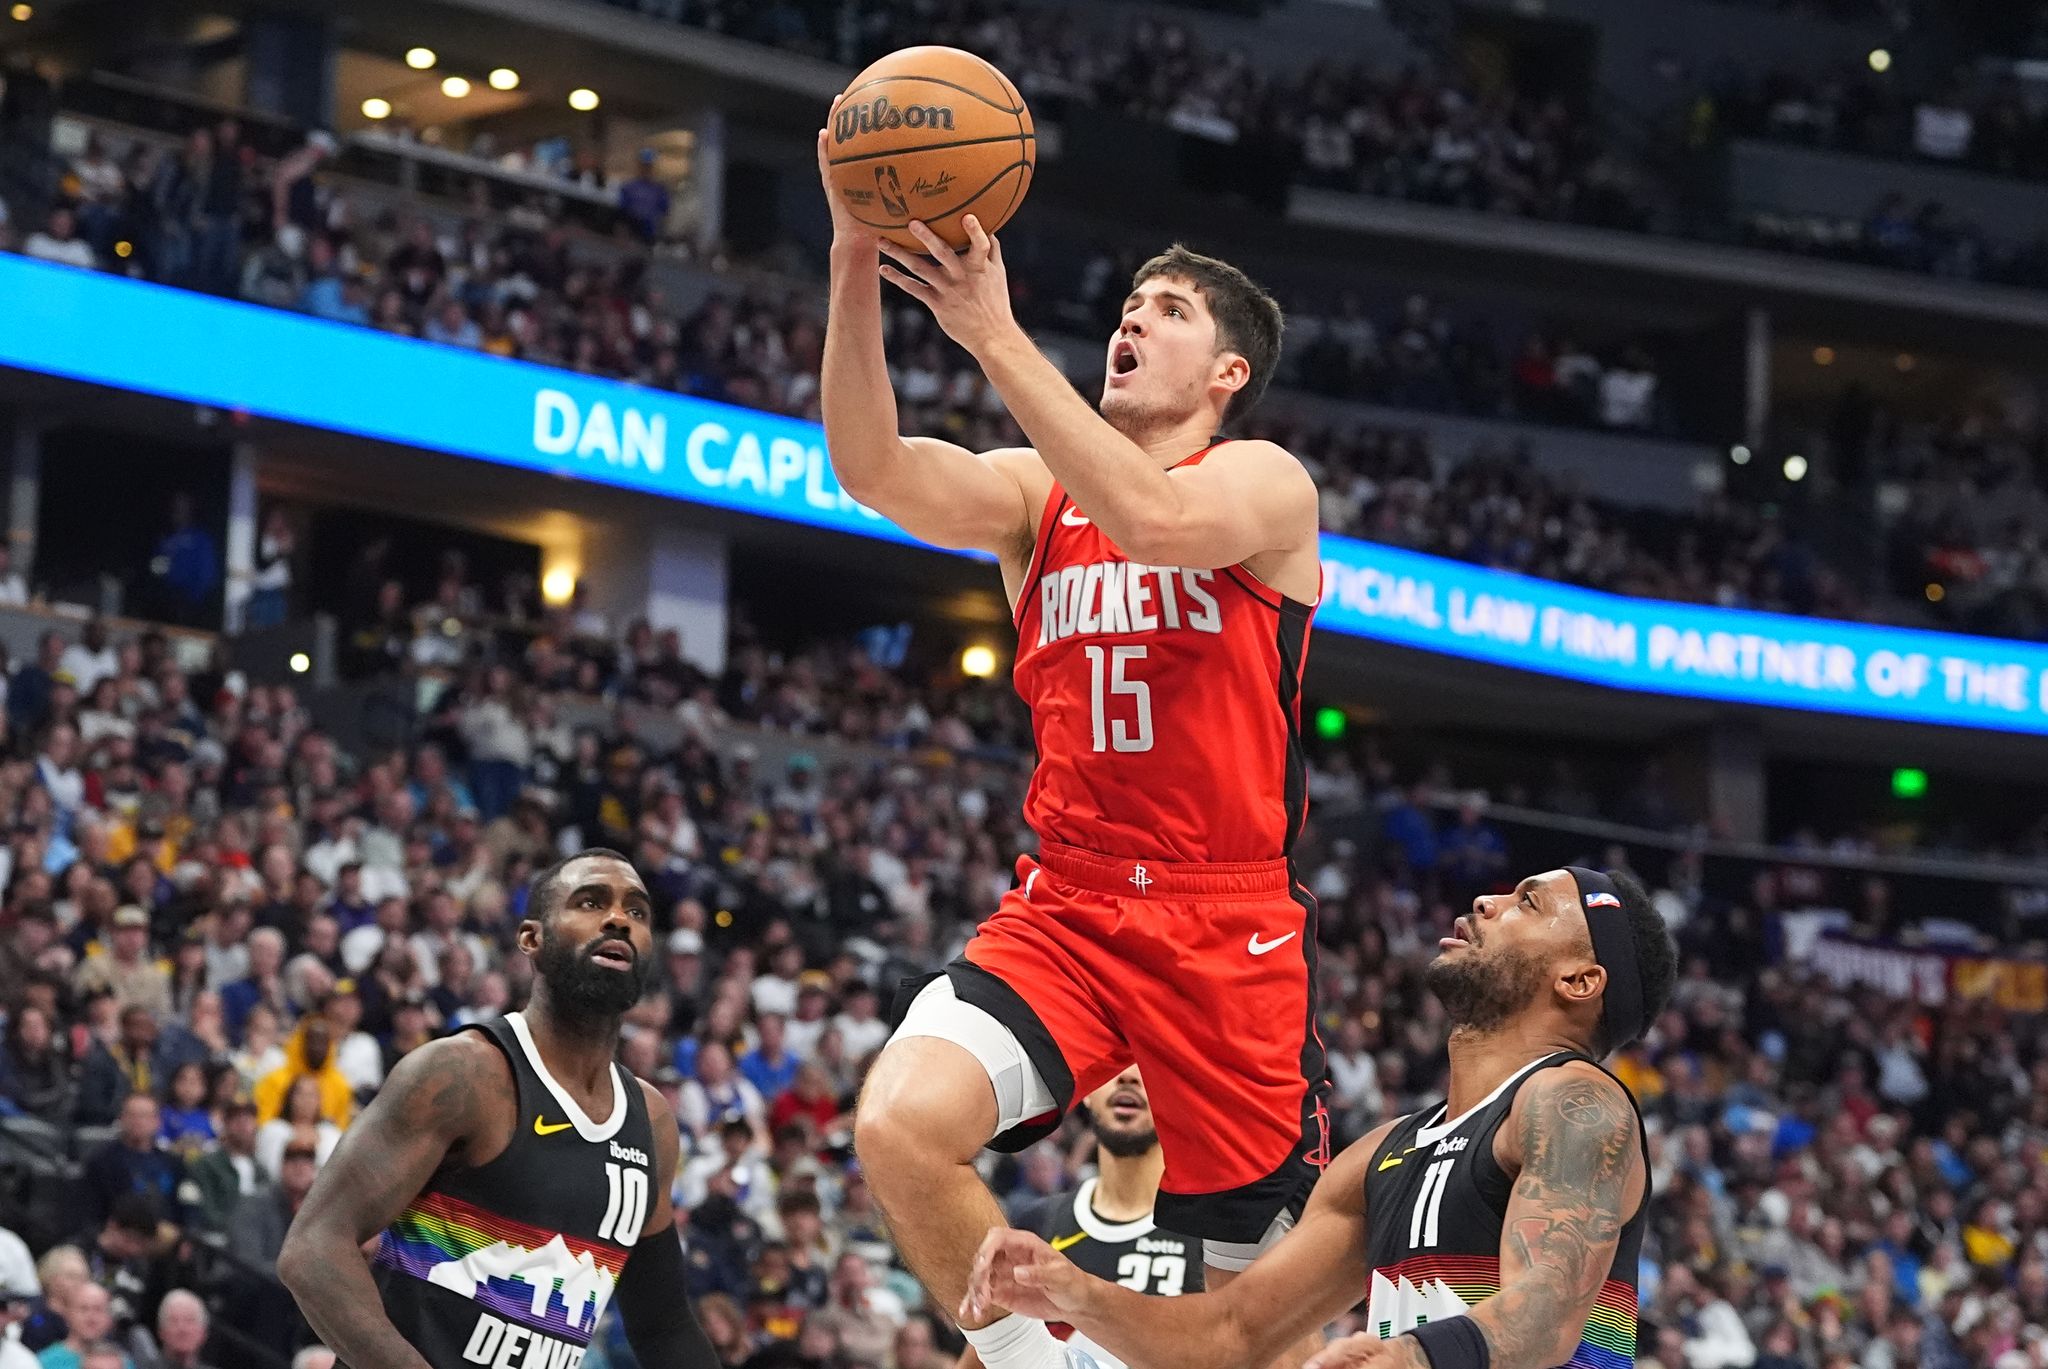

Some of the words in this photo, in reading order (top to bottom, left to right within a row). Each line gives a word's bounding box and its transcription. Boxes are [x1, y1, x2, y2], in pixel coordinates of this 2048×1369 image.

[835, 96, 955, 144] Wilson
[533, 389, 667, 473] DAN
[685, 422, 884, 521] CAPL
[1037, 561, 1223, 649] ROCKETS
[1447, 587, 1537, 646] LAW
[1540, 605, 1637, 667] FIRM
[1647, 624, 1857, 692] PARTNER
[1865, 649, 1930, 699] OF
[1940, 656, 2029, 712] THE
[1085, 645, 1154, 753] 15
[609, 1140, 649, 1167] ibotta
[597, 1162, 649, 1247] 10
[1136, 1237, 1185, 1255] ibotta
[1409, 1159, 1455, 1249] 11
[1117, 1253, 1187, 1297] 23
